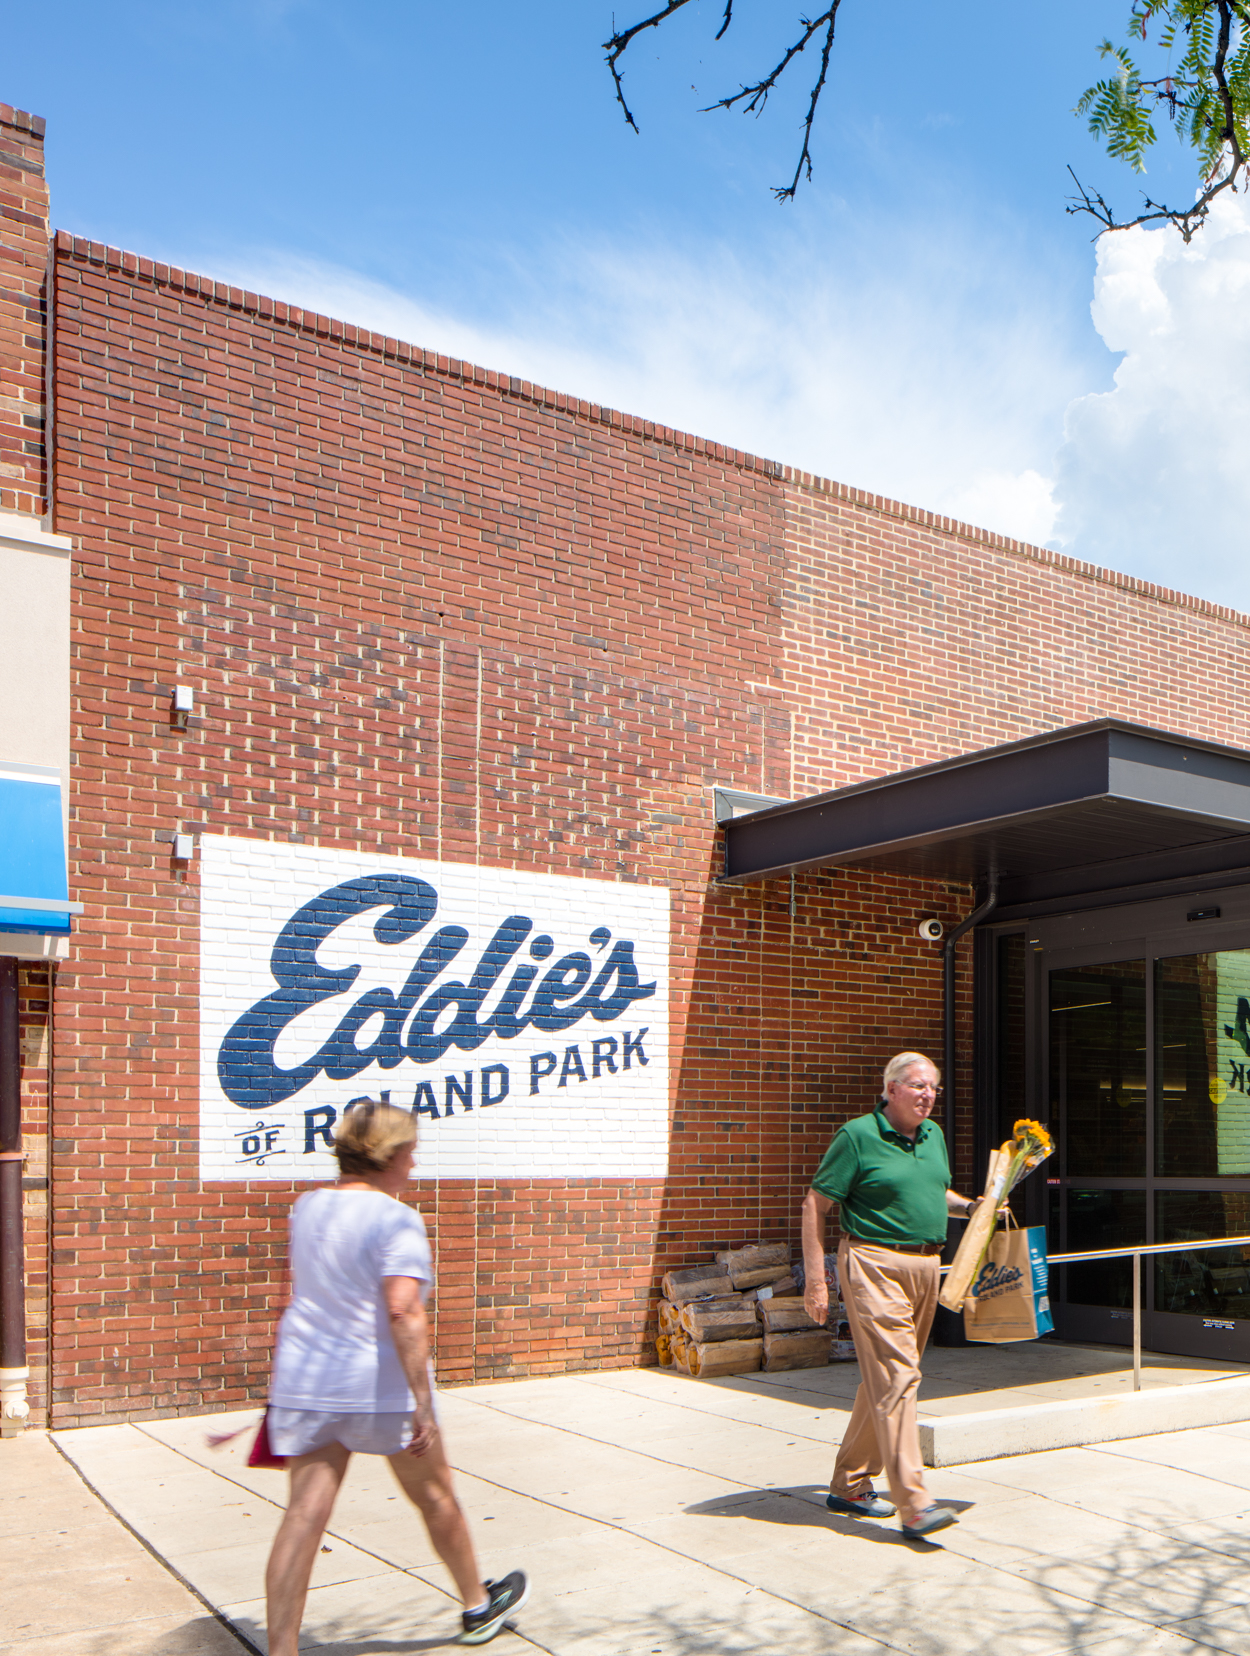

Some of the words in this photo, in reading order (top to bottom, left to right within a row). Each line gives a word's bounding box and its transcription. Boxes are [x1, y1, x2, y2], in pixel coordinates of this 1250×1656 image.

[217, 873, 657, 1110] Eddie's
[240, 1128, 281, 1157] OF
[302, 1062, 510, 1155] RAND
[528, 1026, 651, 1097] PARK
[972, 1261, 1024, 1298] Eddie's
